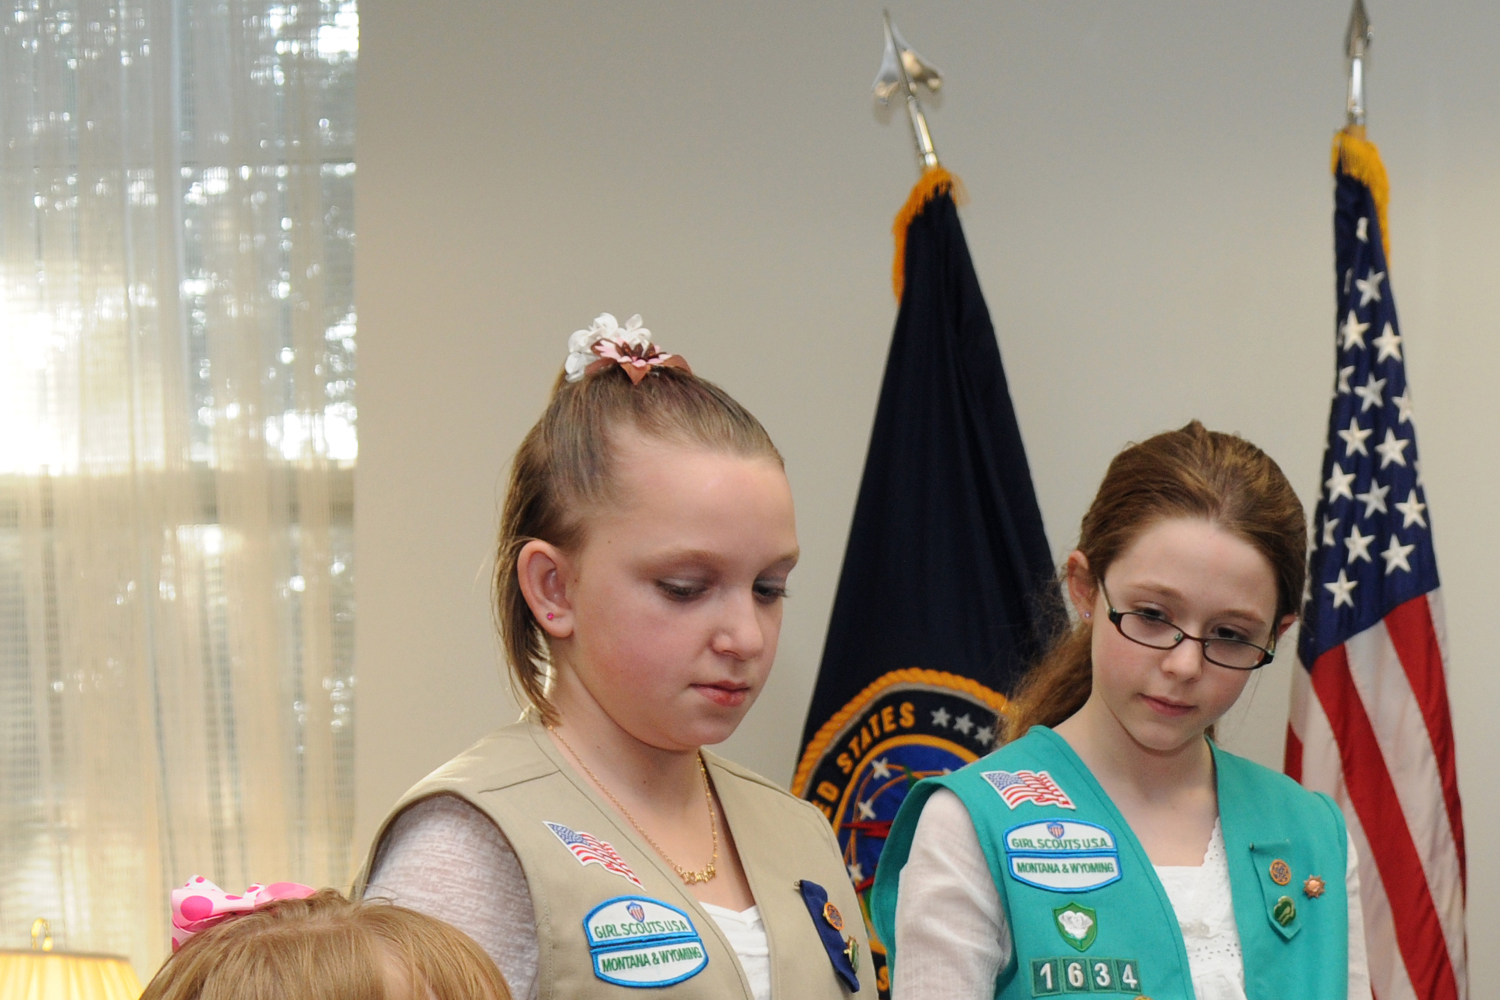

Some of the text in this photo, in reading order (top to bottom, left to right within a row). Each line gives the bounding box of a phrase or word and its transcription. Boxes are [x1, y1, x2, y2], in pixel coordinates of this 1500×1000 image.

[836, 701, 916, 775] STATES
[1012, 838, 1036, 848] GIRL
[1037, 838, 1081, 849] SCOUTS
[1016, 862, 1114, 873] MONTANA & WYOMING
[594, 923, 622, 939] GIRL
[620, 921, 665, 936] SCOUTS
[601, 947, 702, 972] MONTANA & WYOMING
[1039, 962, 1137, 990] 1634
